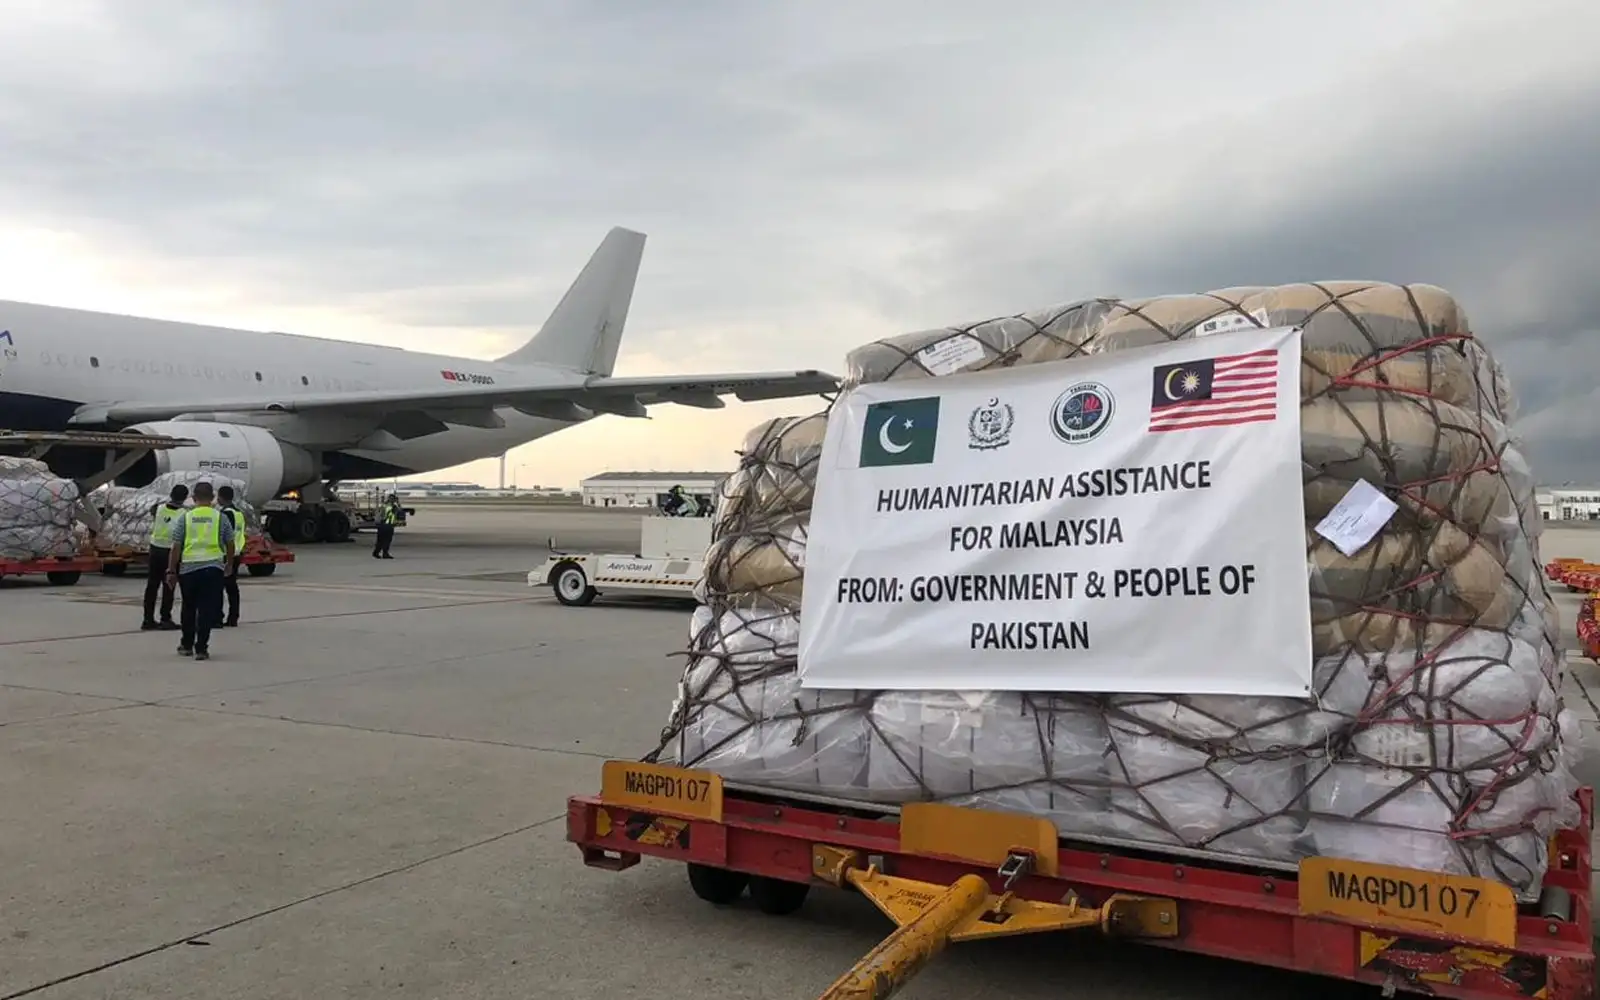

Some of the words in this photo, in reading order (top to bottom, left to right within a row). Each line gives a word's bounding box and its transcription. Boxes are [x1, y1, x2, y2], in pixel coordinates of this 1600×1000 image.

[198, 460, 249, 470] PRIME
[877, 477, 1054, 512] HUMANITARIAN
[1058, 460, 1212, 499] ASSISTANCE
[950, 526, 993, 552] FOR
[999, 517, 1124, 549] MALAYSIA
[837, 577, 903, 604] FROM:
[910, 572, 1078, 603] GOVERNMENT
[1084, 571, 1106, 599] &
[1114, 566, 1212, 598] PEOPLE
[1219, 564, 1256, 596] OF
[970, 621, 1090, 650] PAKISTAN
[625, 771, 711, 802] MAGPD107
[1327, 870, 1481, 919] MAGPD107
